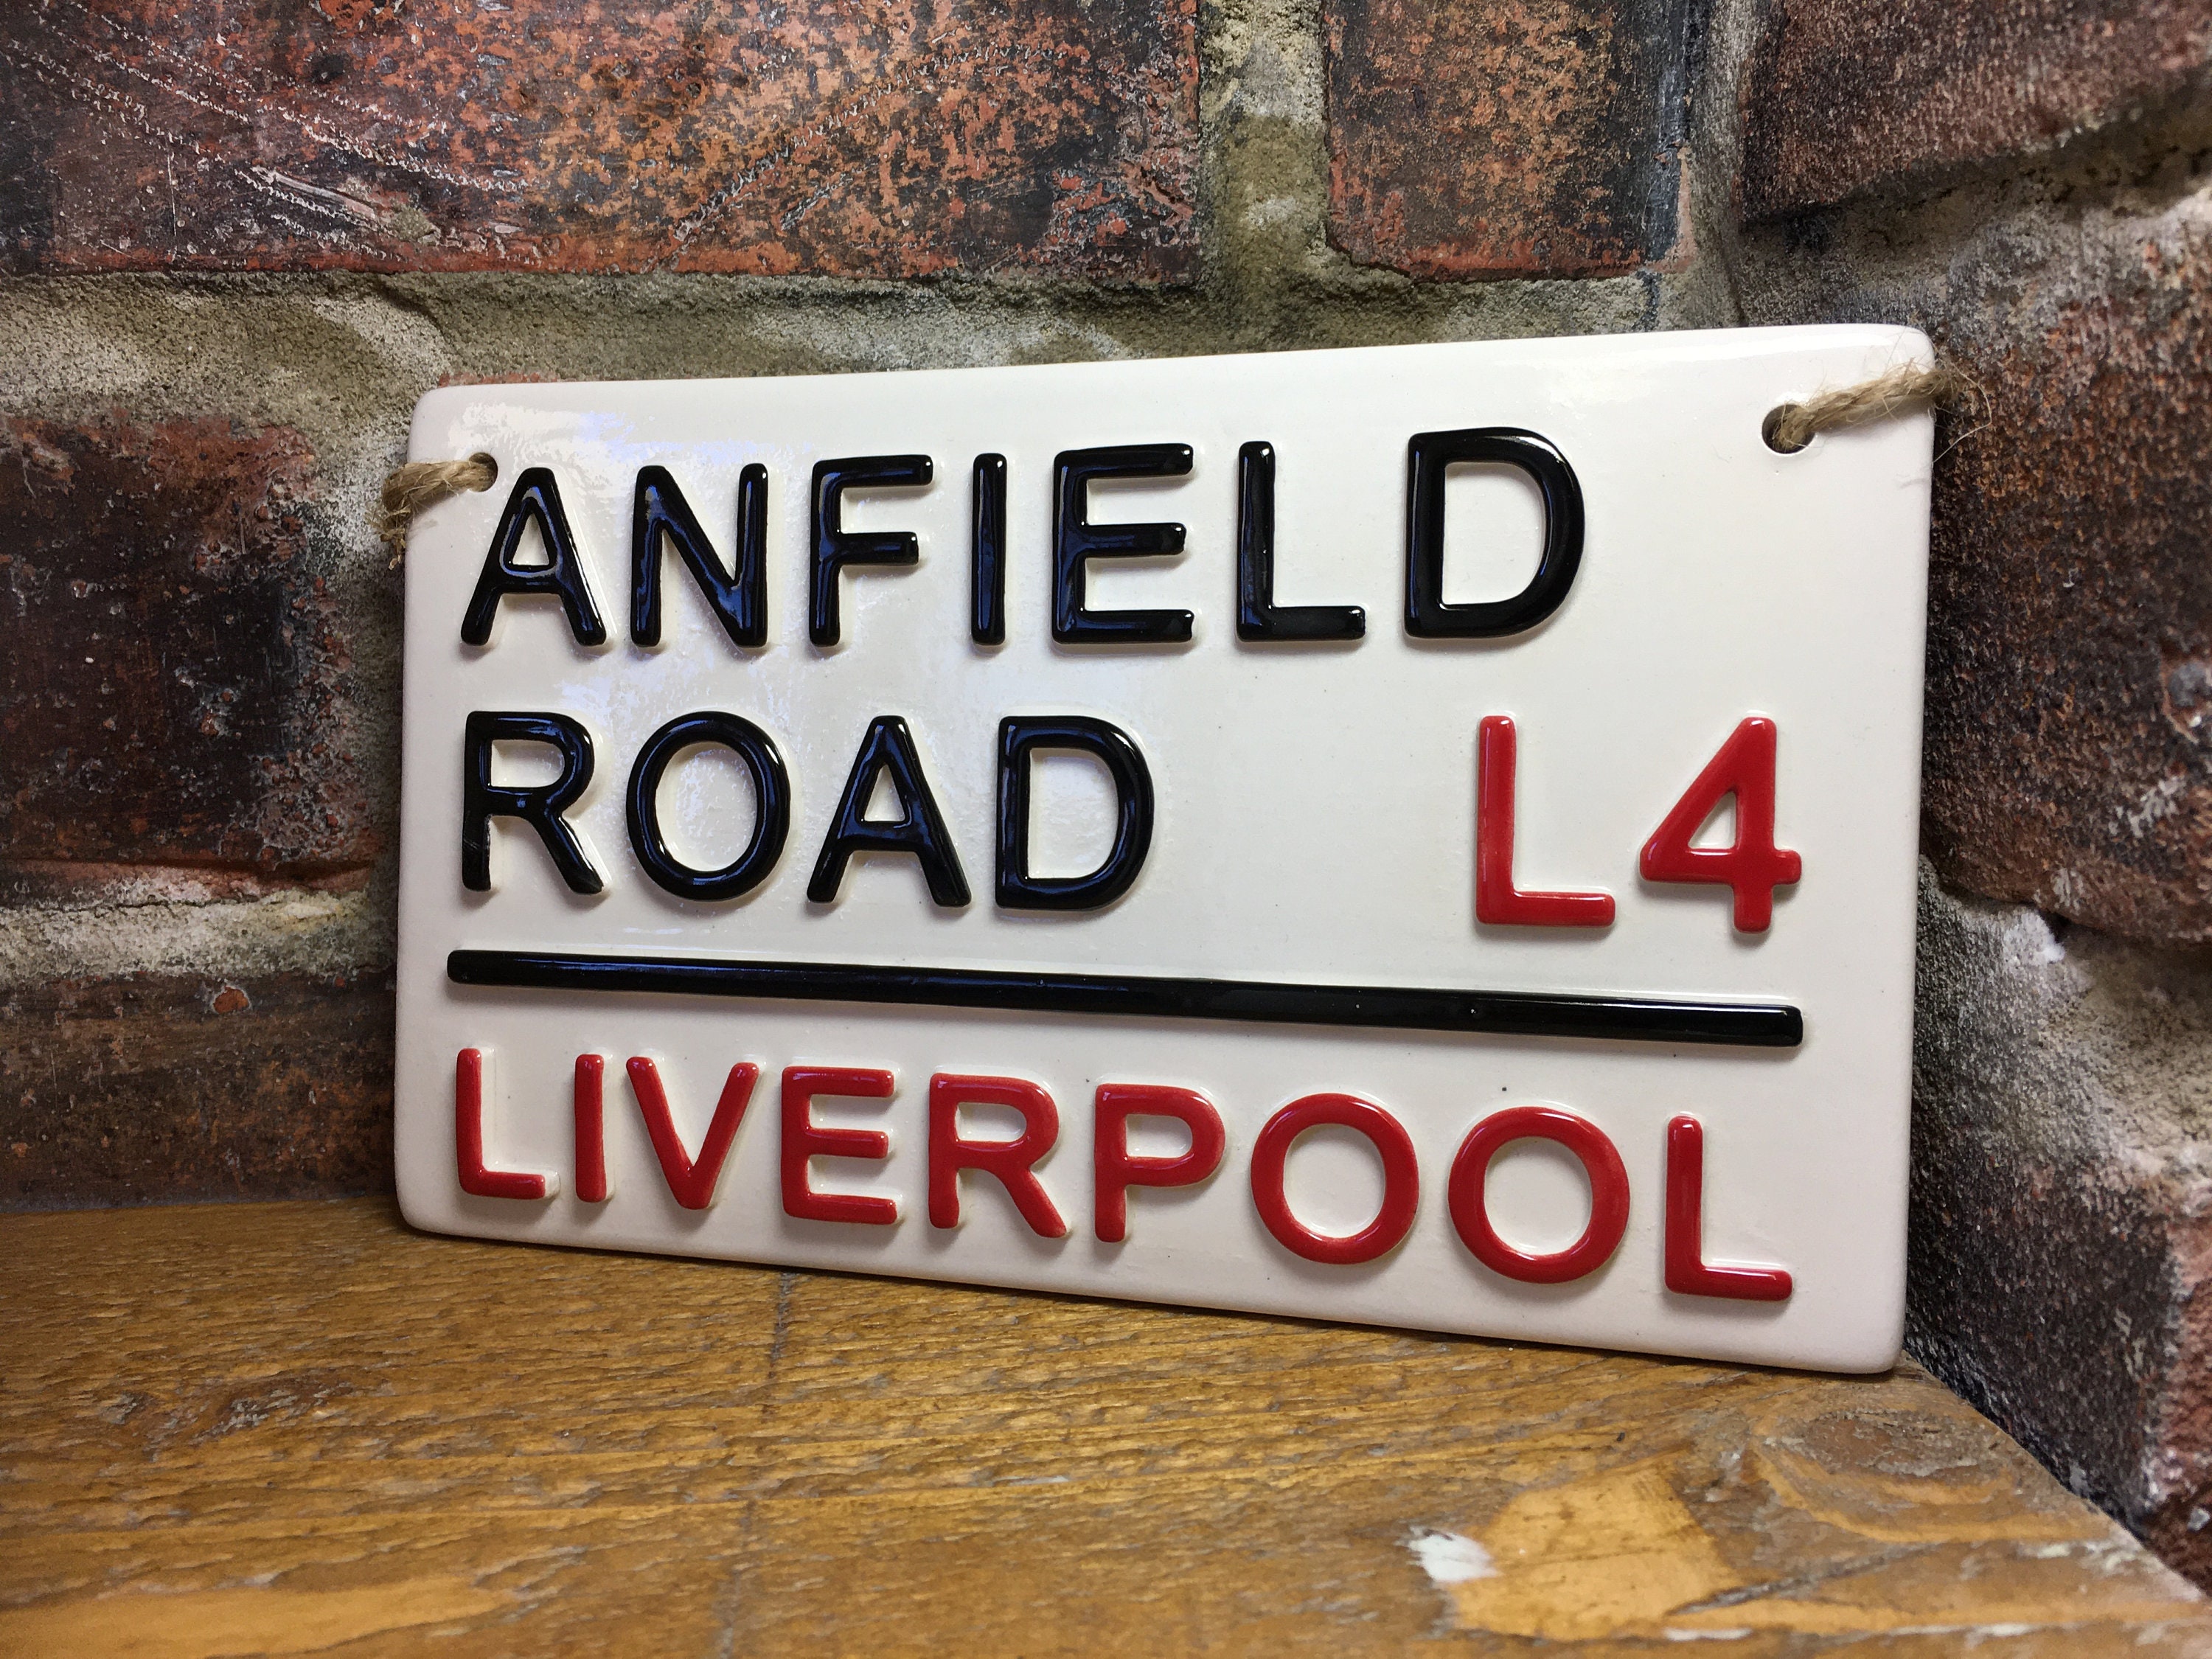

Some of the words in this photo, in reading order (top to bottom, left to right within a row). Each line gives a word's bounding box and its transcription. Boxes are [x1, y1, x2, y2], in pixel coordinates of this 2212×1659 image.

[460, 426, 1587, 650] ANFIELD
[460, 710, 1155, 917] ROAD
[1475, 715, 1803, 933] L4
[455, 1047, 1793, 1301] LIVERPOOL
